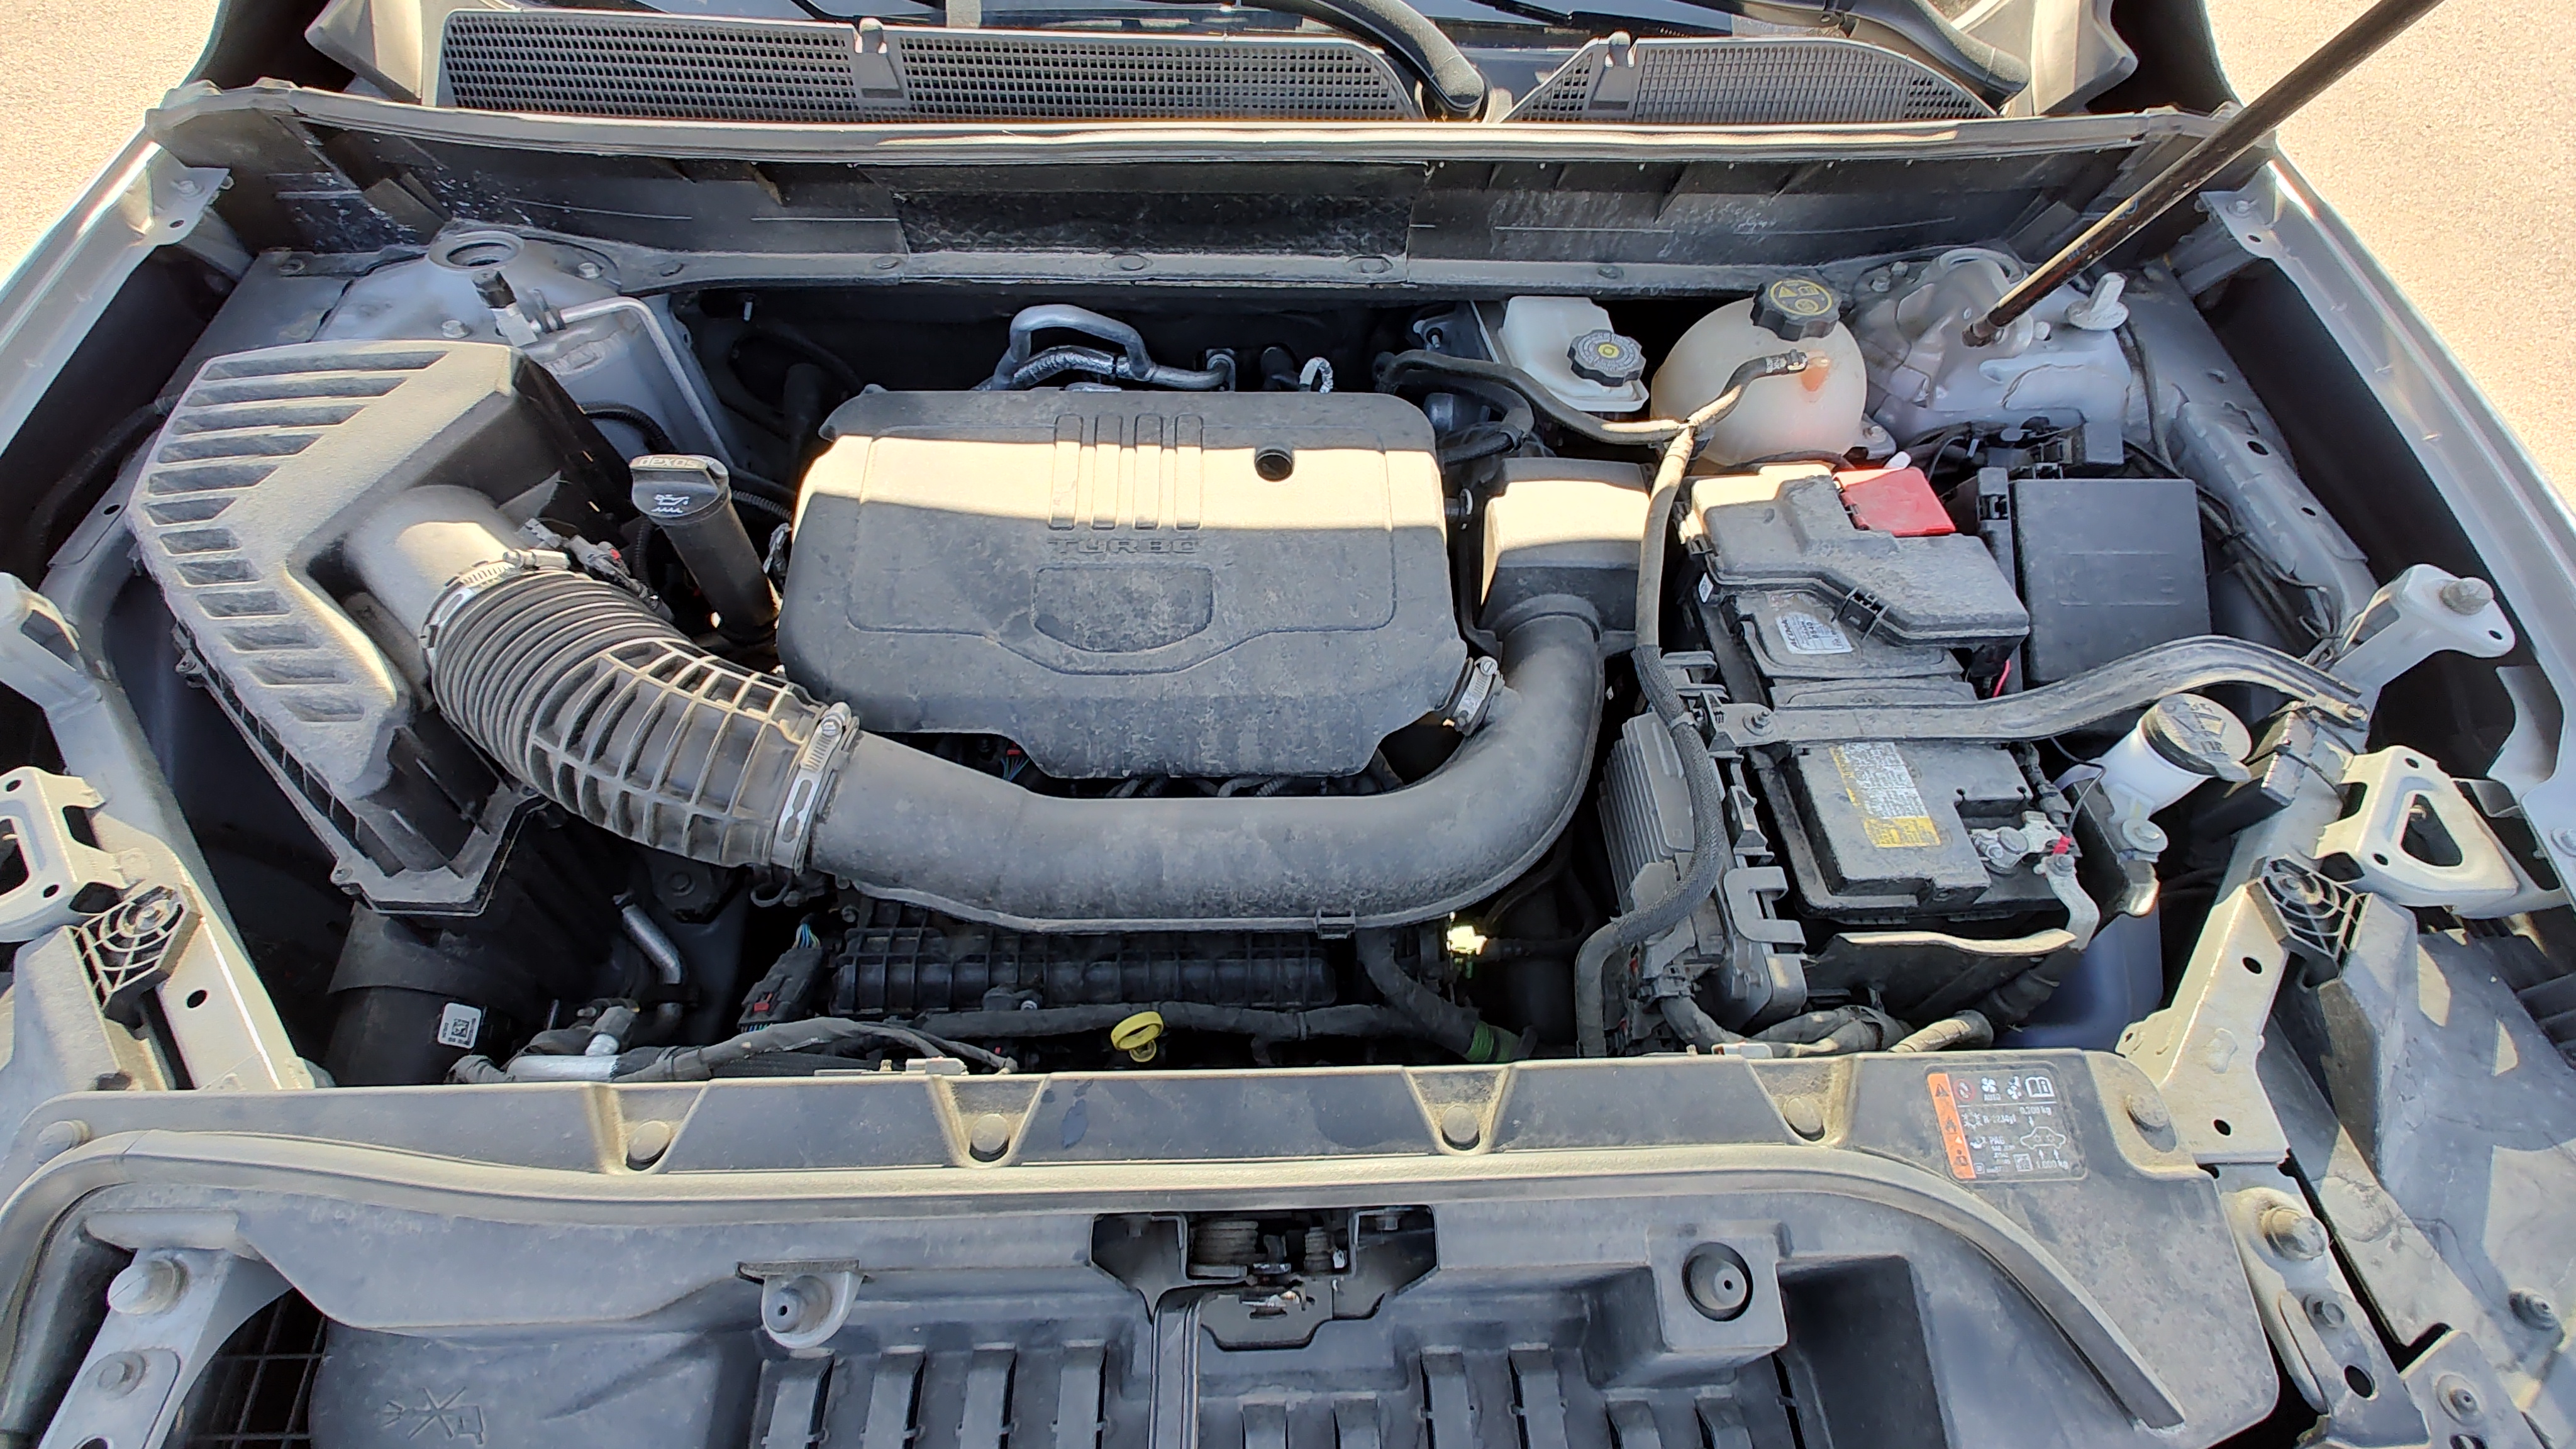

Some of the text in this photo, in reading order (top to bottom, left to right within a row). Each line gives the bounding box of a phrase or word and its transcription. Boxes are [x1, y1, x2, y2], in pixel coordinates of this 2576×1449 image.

[639, 456, 698, 467] dexos
[1048, 539, 1198, 554] TURBO
[1989, 1136, 2005, 1145] PAG
